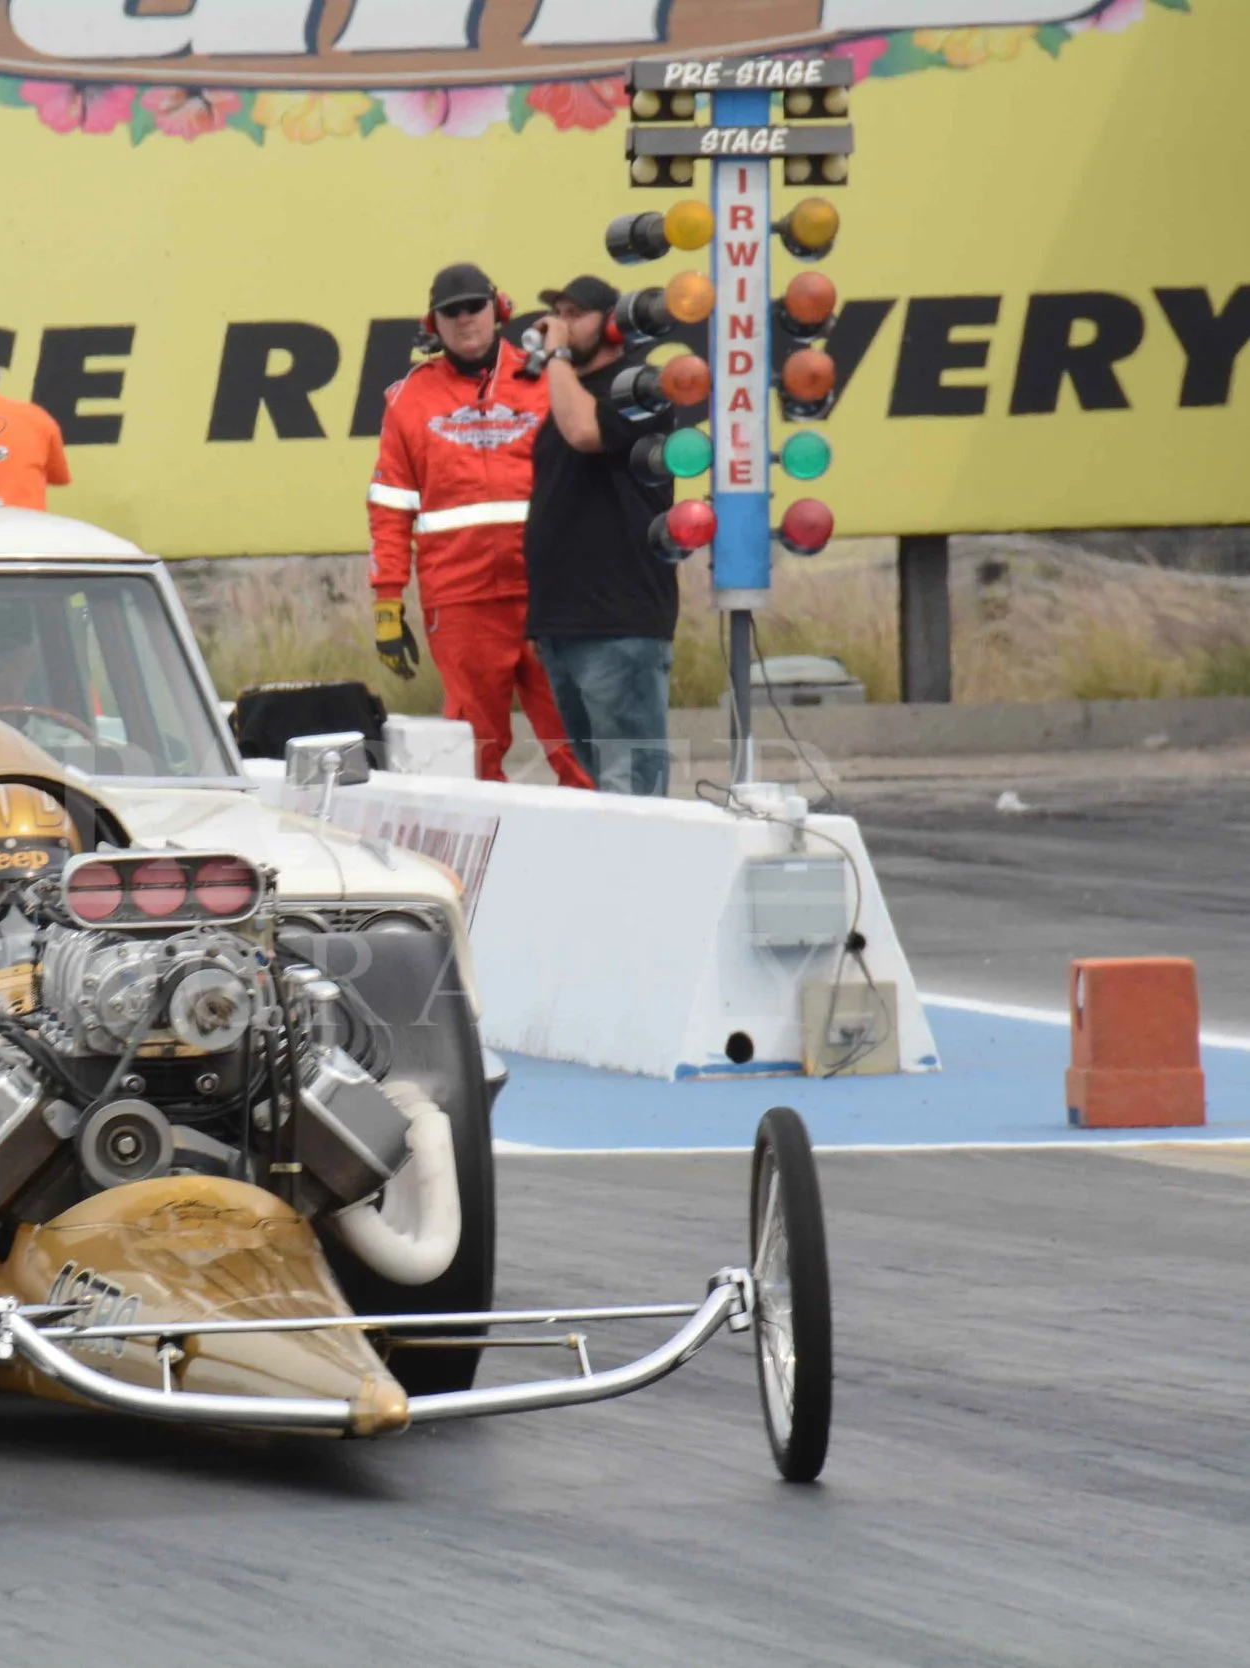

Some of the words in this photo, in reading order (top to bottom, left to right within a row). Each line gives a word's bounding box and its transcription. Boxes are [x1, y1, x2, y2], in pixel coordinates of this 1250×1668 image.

[663, 59, 825, 88] PRE-STAGE
[700, 127, 789, 154] STAGE
[725, 167, 759, 486] IRWINDALE
